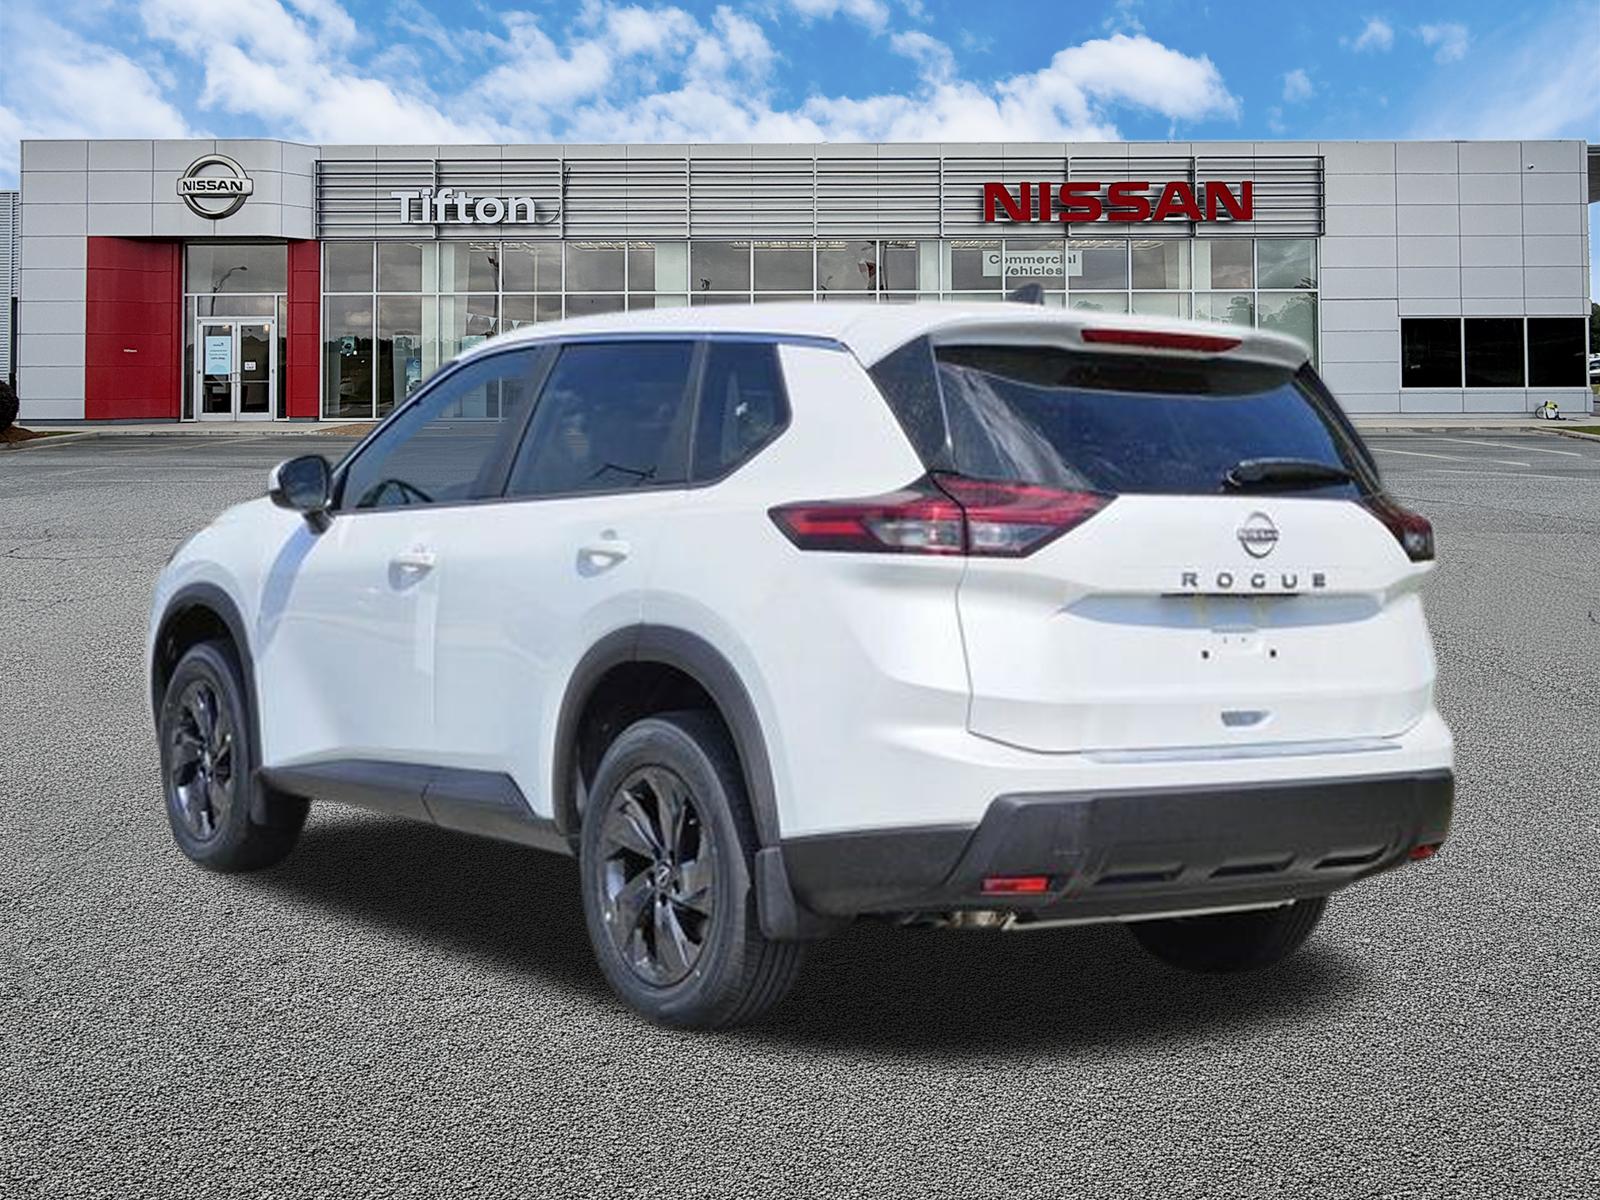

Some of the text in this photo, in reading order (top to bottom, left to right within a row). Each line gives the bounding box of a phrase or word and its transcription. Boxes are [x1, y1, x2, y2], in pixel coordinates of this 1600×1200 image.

[182, 180, 243, 191] NISSAN
[391, 187, 536, 224] Tifton
[983, 181, 1253, 223] NISSAN
[1181, 572, 1326, 588] ROGUE
